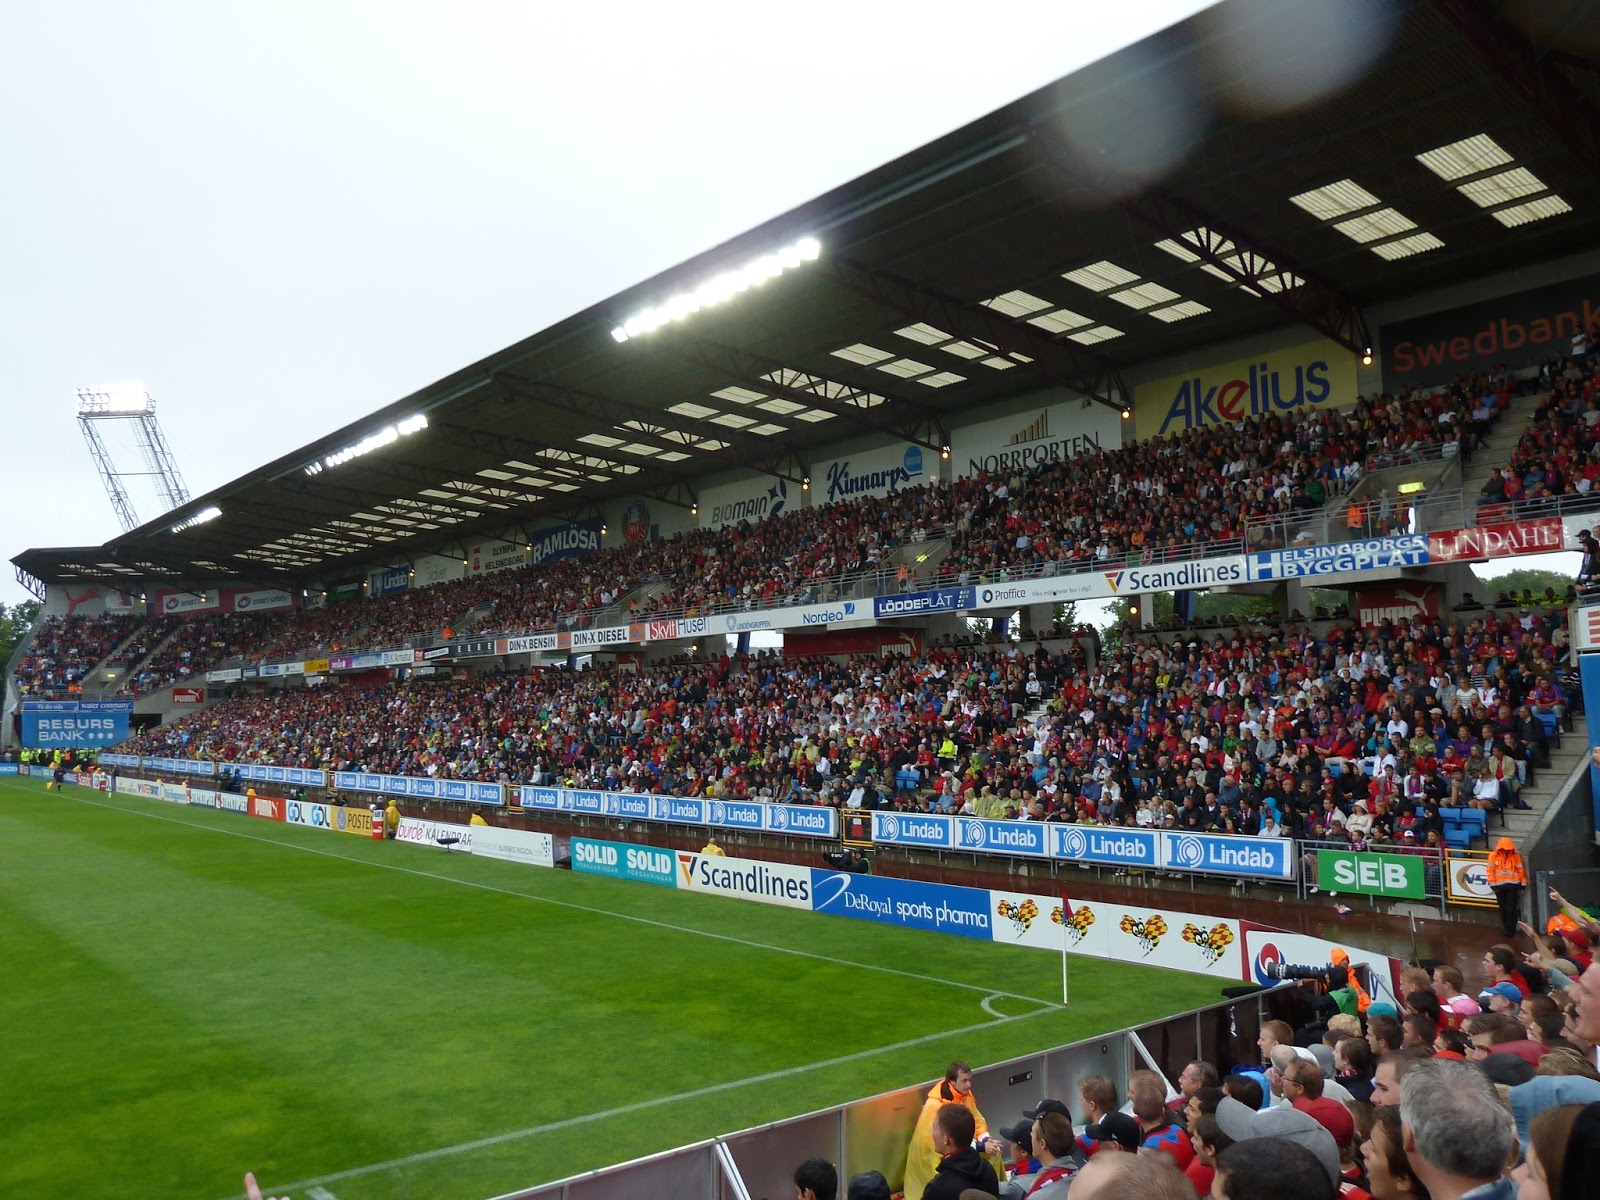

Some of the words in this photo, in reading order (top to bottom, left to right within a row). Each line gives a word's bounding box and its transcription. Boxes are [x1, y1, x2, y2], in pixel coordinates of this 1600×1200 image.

[1158, 360, 1331, 435] Akelius
[969, 430, 1099, 478] NORRPORTEN
[826, 461, 911, 502] Kinnarps
[711, 496, 769, 524] BIOMAIN
[492, 543, 517, 556] OLYMPIA
[533, 523, 599, 564] RAMLÖSA
[1437, 525, 1560, 557] LINDAHL
[484, 555, 525, 571] HELSINGBORG
[384, 571, 408, 590] Lindab
[1129, 563, 1241, 591] Scandlines
[878, 592, 953, 613] LÖDDEPLÅT
[995, 588, 1027, 601] Proffice
[802, 610, 844, 624] Nordea
[509, 638, 528, 651] DIN-X
[529, 636, 556, 650] BENSIN
[573, 631, 596, 645] DIN-X
[597, 628, 628, 643] DIESEL
[881, 643, 911, 659] PUMA
[100, 702, 130, 711] company
[38, 719, 115, 730] RESURS
[38, 731, 85, 742] BANK
[392, 781, 406, 791] Lindab
[418, 783, 434, 793] Lindab
[448, 785, 464, 796] Lindab
[480, 787, 498, 799] Lindab
[535, 792, 556, 805] Lindab
[576, 794, 599, 808] Lindab
[621, 798, 646, 813] Lindab
[672, 802, 699, 818] Lindab
[728, 807, 758, 824] Lindab
[790, 811, 826, 829] Lindab
[902, 820, 944, 840] Lindab
[989, 826, 1037, 848] Lindab
[1090, 835, 1147, 858] Lindab
[575, 842, 618, 866] SOLID
[626, 848, 672, 874] SOLID
[1209, 843, 1275, 869] Lindab
[700, 860, 809, 901] Scandlines
[1333, 857, 1408, 890] SEB
[1463, 872, 1489, 887] NS
[844, 891, 892, 918] DeRoyal
[896, 901, 933, 922] sports
[935, 900, 989, 928] pharma
